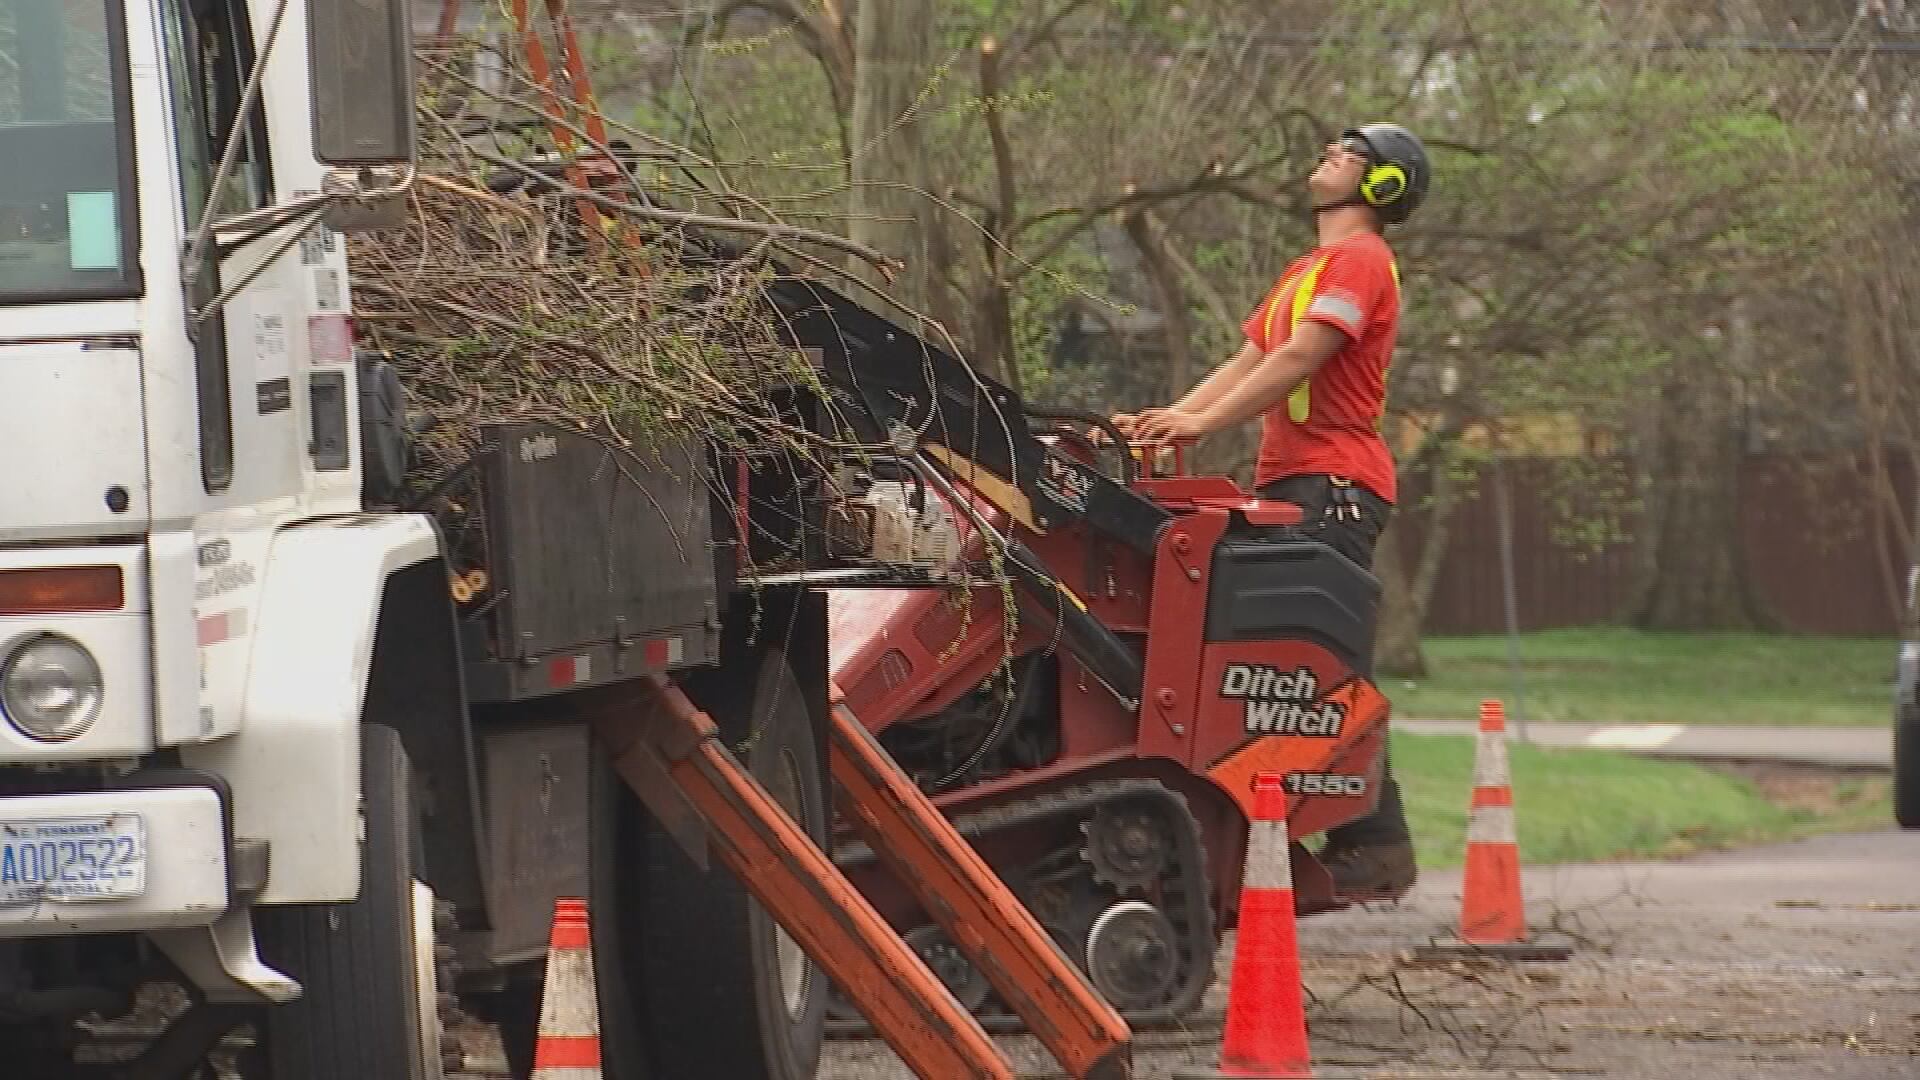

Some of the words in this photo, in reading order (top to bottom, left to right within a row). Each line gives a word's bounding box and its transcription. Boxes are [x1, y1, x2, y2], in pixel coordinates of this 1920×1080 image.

[1221, 664, 1317, 699] Ditch
[1246, 700, 1342, 735] Witch
[2, 836, 134, 882] A002522
